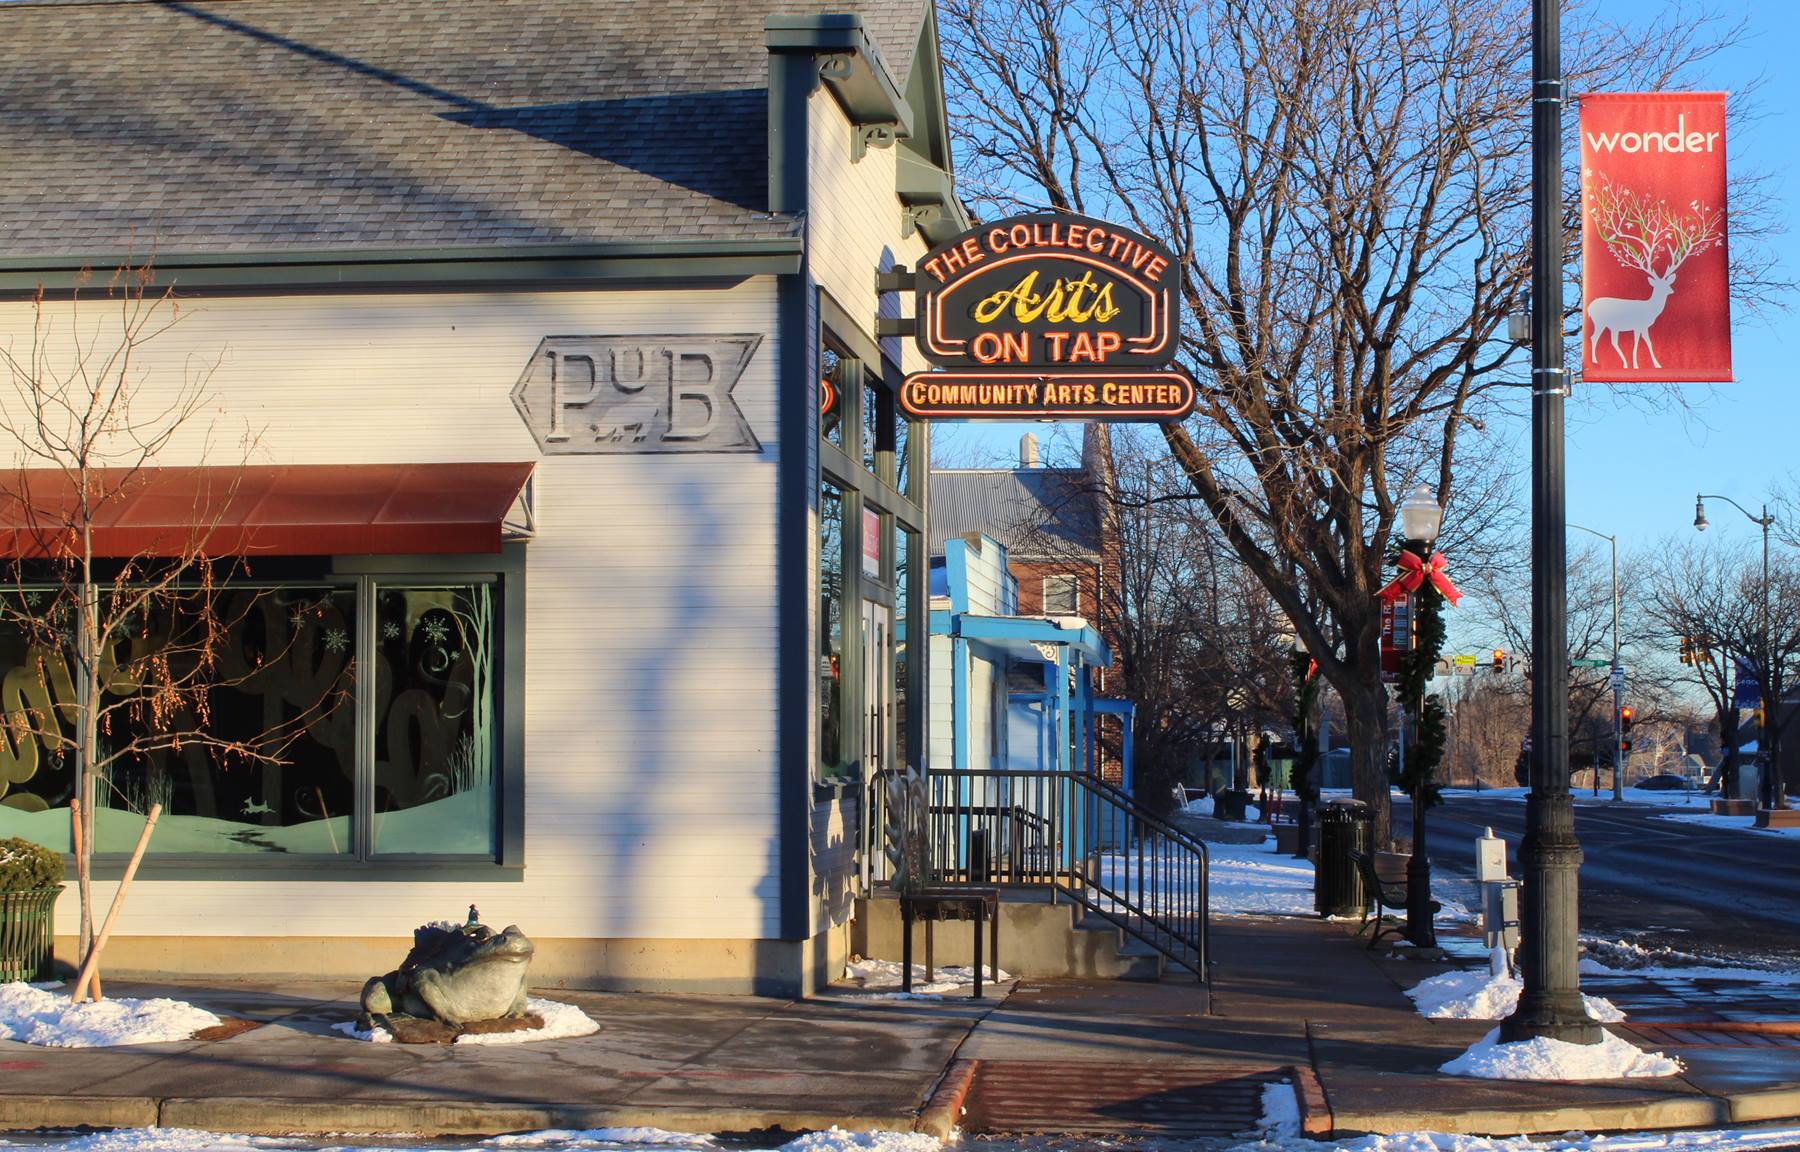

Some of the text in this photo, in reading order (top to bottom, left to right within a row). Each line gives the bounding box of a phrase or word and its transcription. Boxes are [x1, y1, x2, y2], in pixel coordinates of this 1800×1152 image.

[1586, 113, 1719, 153] wonder
[924, 223, 1169, 283] THE COLLECTIVE
[974, 270, 1121, 324] Arts
[973, 330, 1122, 364] ON TAP
[912, 382, 1182, 405] COMMUNITY ARTS CENTER
